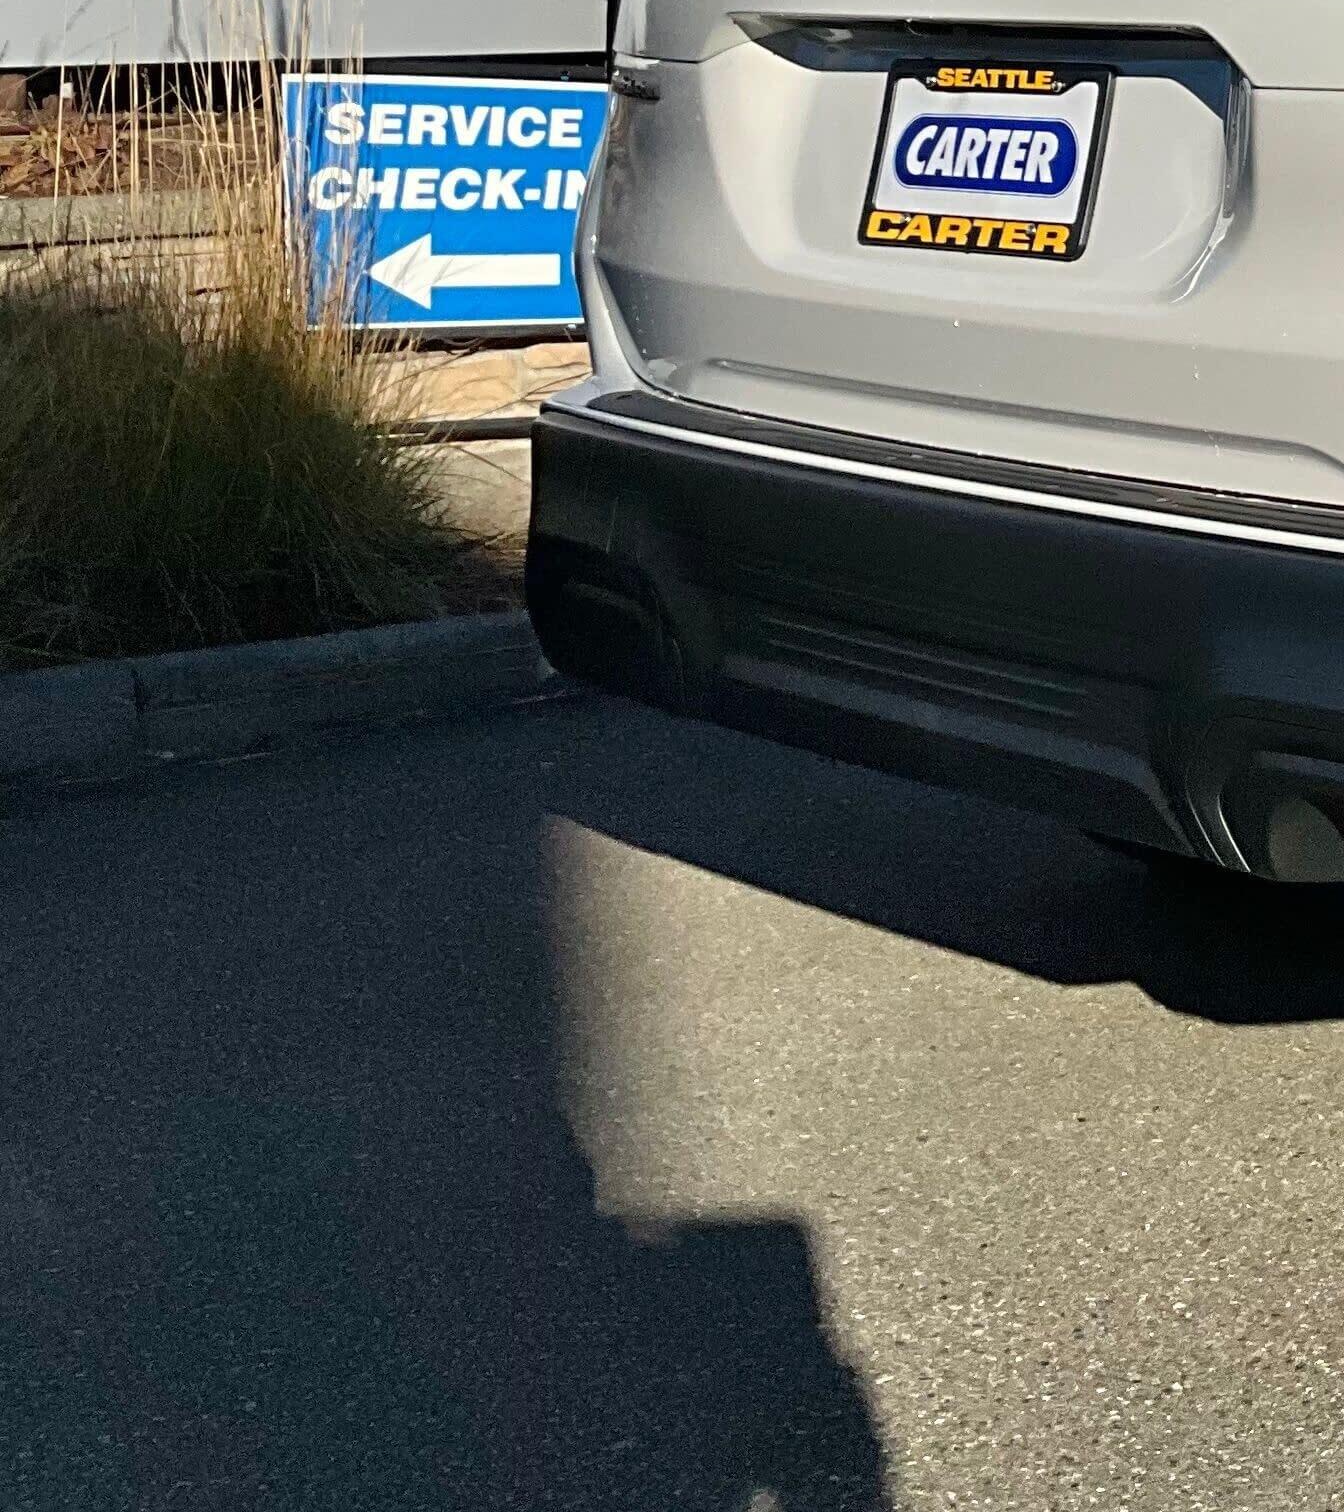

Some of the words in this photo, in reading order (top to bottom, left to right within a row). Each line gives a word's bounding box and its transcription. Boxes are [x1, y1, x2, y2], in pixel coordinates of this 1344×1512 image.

[936, 67, 1054, 90] SEATTLE
[323, 101, 583, 148] SERVICE
[905, 124, 1059, 183] CARTER
[866, 211, 1070, 254] CARTER
